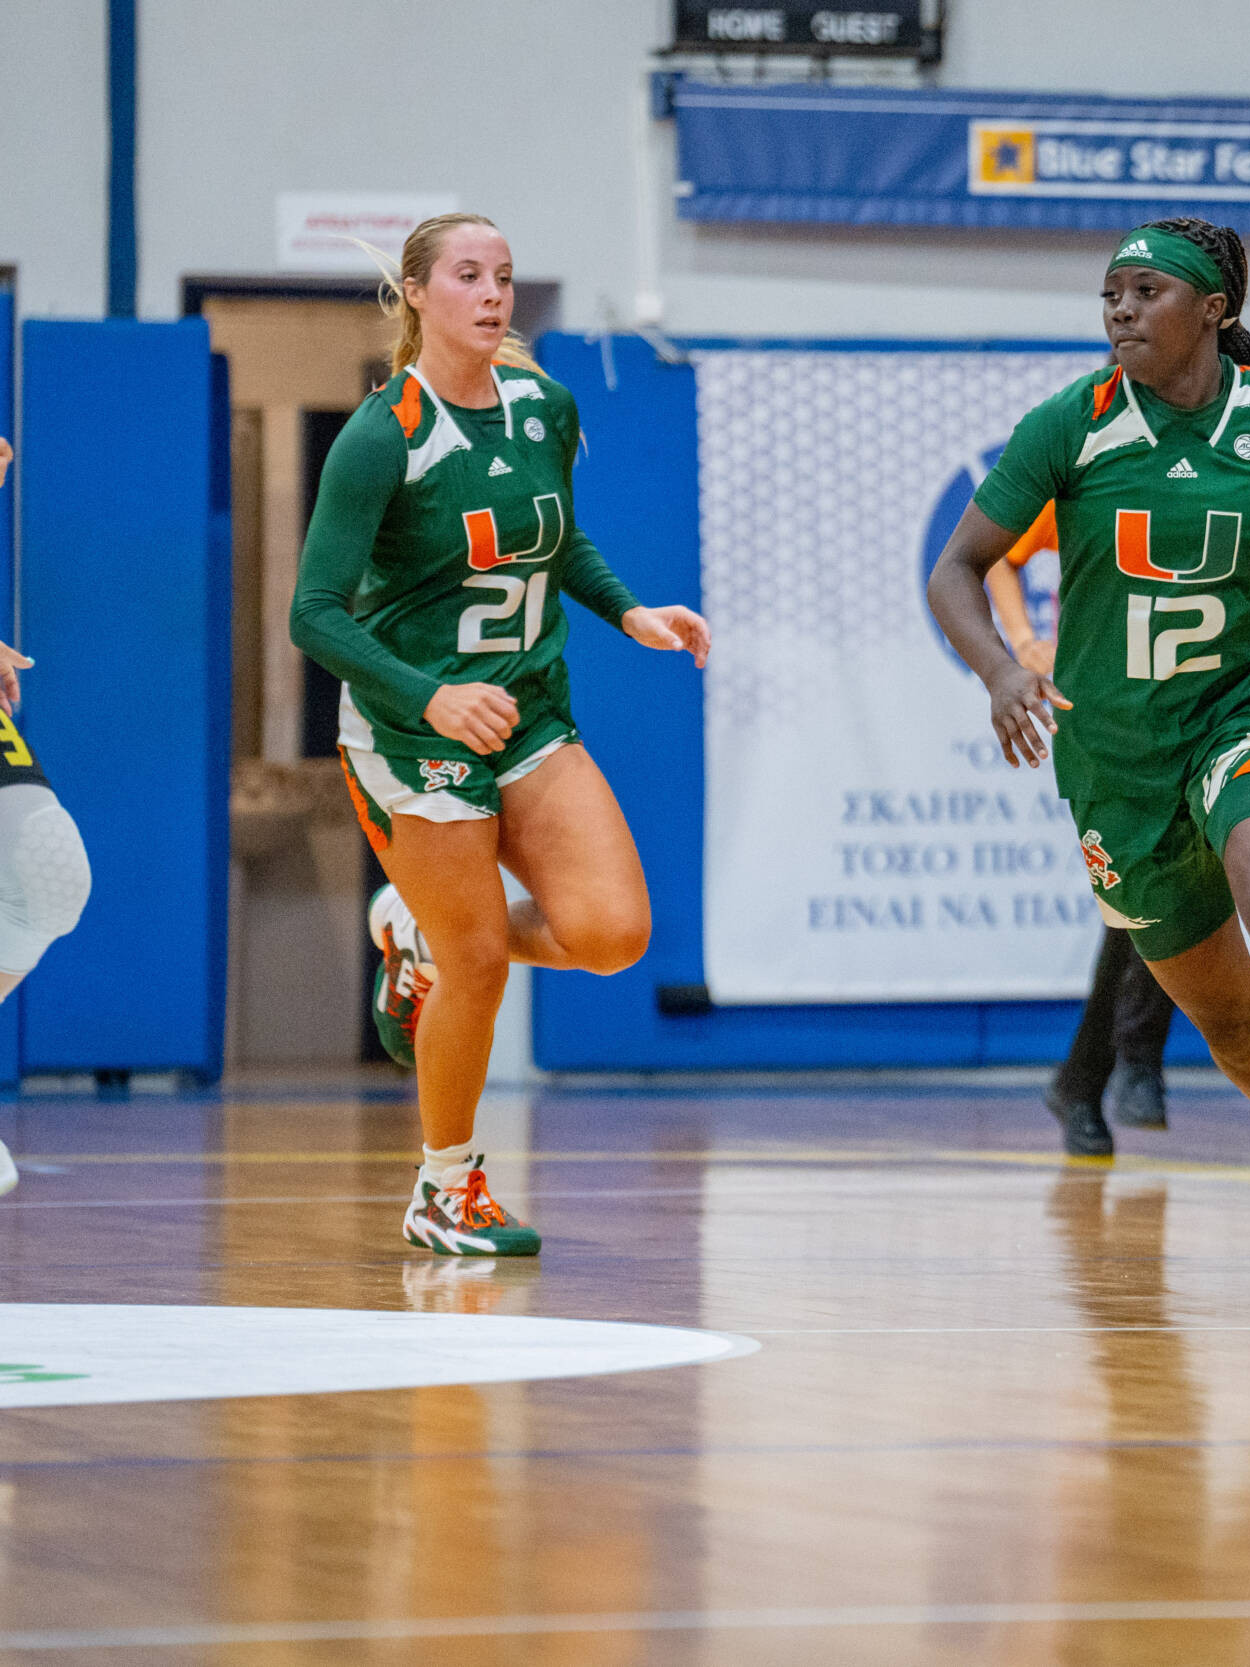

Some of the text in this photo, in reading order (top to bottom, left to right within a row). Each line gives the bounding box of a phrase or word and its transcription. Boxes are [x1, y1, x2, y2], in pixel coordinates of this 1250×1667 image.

[707, 9, 900, 45] HOME GUEST
[1037, 138, 1122, 180] Blue
[1129, 140, 1208, 181] Star
[1115, 250, 1153, 260] adidas
[1166, 471, 1198, 479] adidas
[461, 493, 564, 571] U
[1115, 508, 1242, 584] U
[457, 572, 548, 653] 21
[1126, 593, 1226, 681] 12
[808, 894, 924, 930] ΕΙΝΑΙ
[940, 894, 998, 928] ΝΑ
